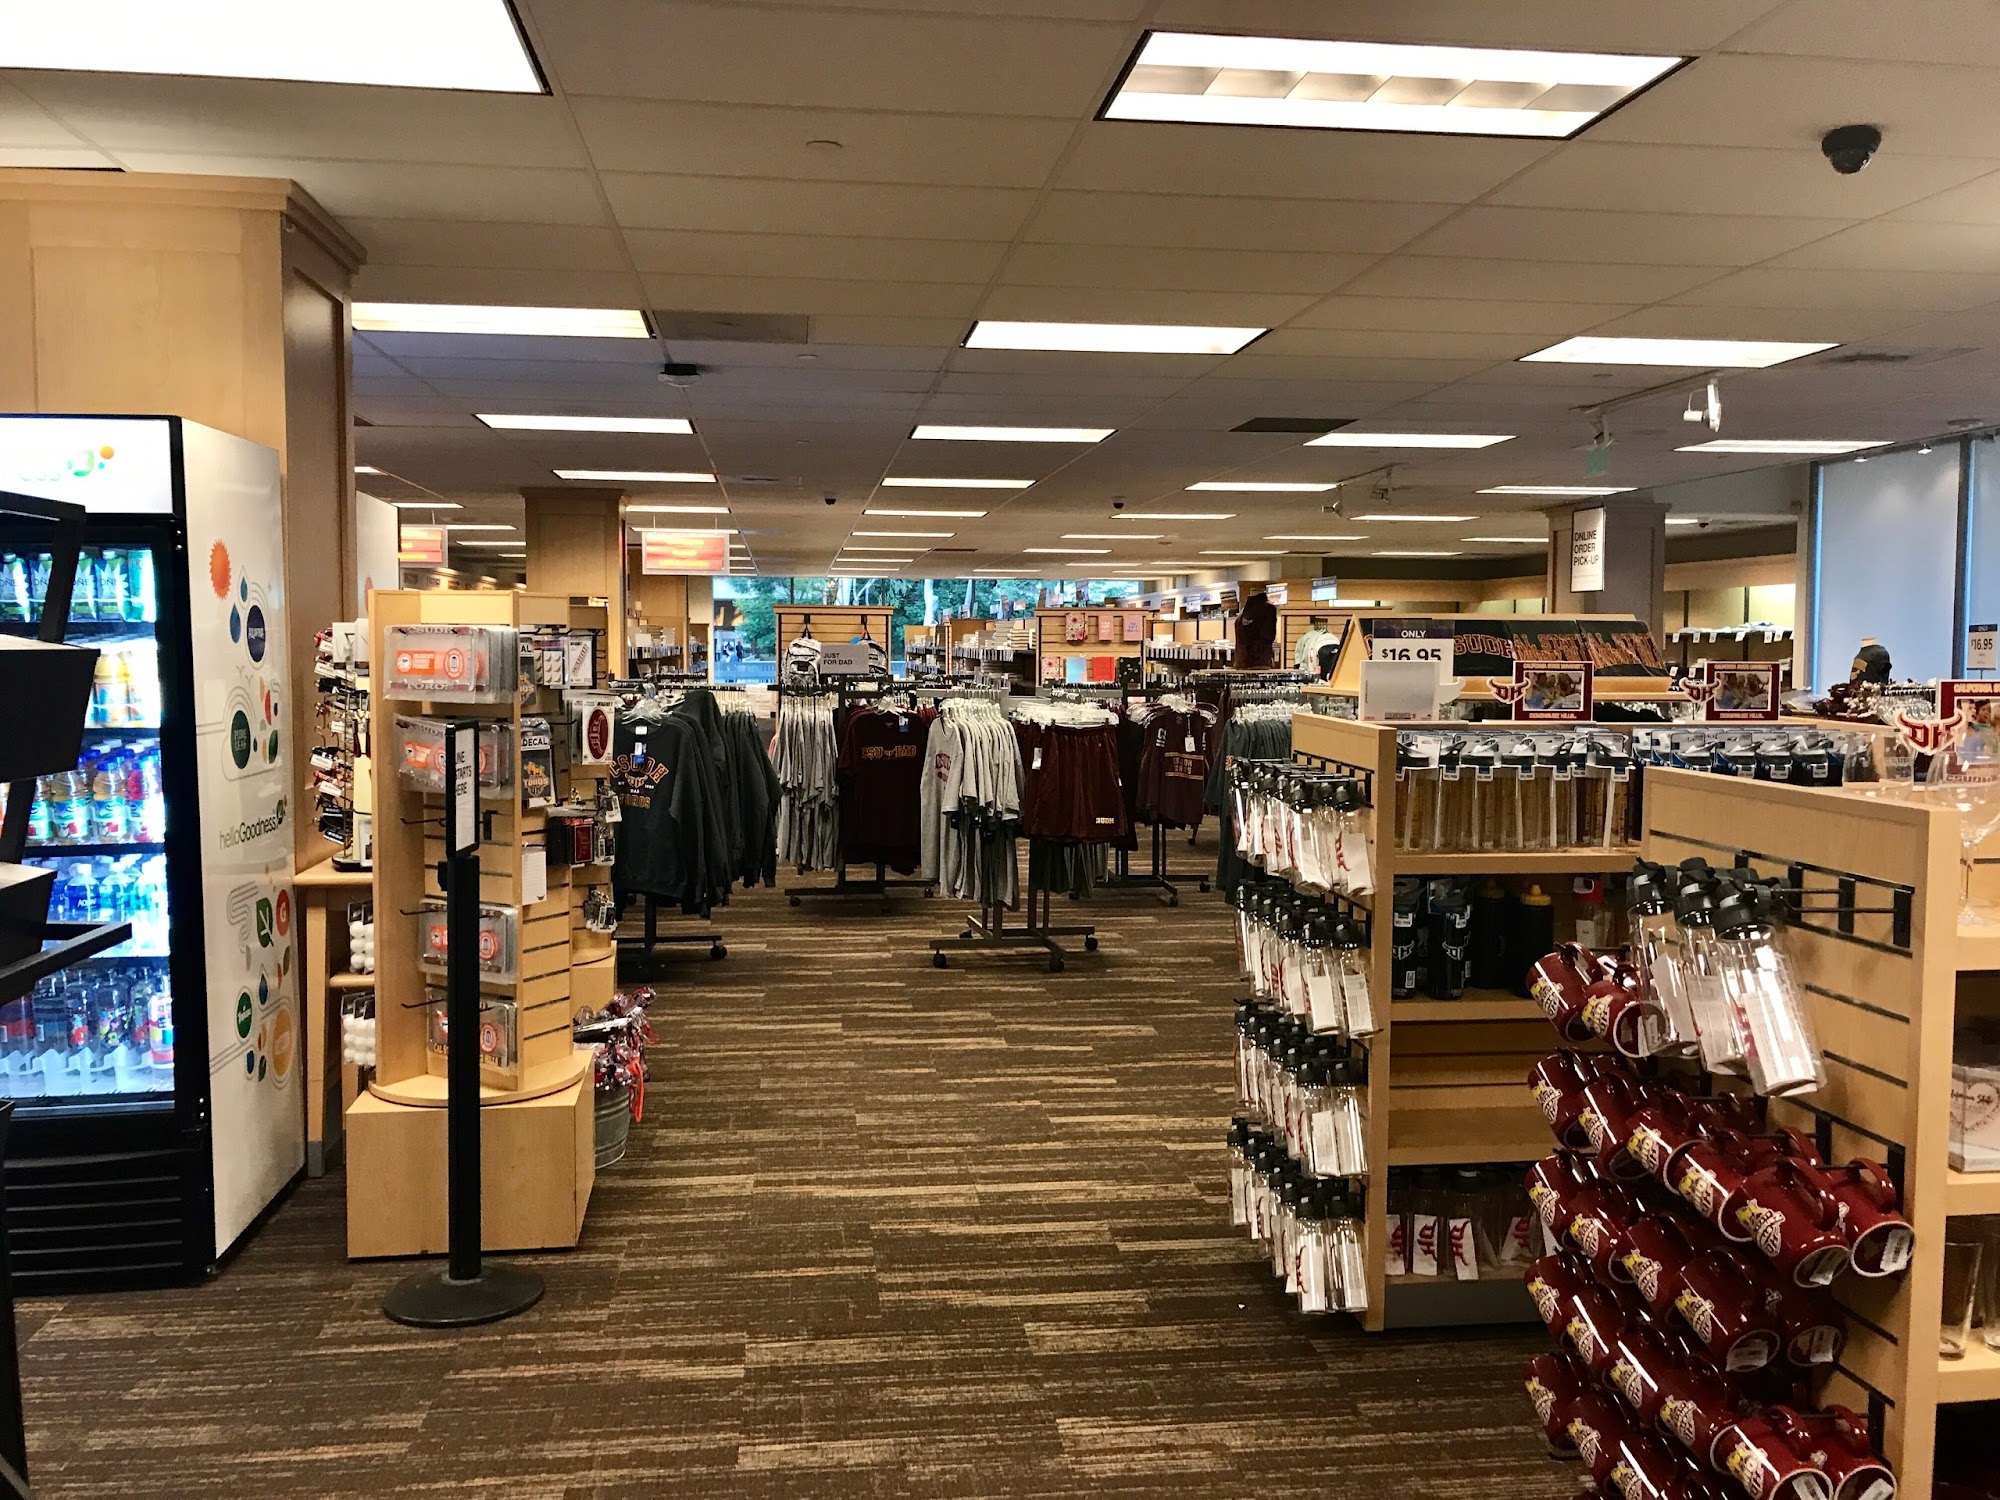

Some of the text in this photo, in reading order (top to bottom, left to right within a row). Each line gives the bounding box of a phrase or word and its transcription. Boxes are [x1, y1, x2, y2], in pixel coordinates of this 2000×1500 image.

[1574, 530, 1597, 541] ONLINE
[1573, 543, 1596, 554] ORDER
[1573, 555, 1599, 566] PICK-UP
[1401, 629, 1427, 638] ONLY
[1453, 632, 1515, 659] SUDH
[1971, 638, 1993, 651] $16.95
[1381, 648, 1442, 661] $1695
[234, 728, 247, 741] PURE
[522, 738, 548, 747] DECAL
[455, 781, 467, 796] ERE
